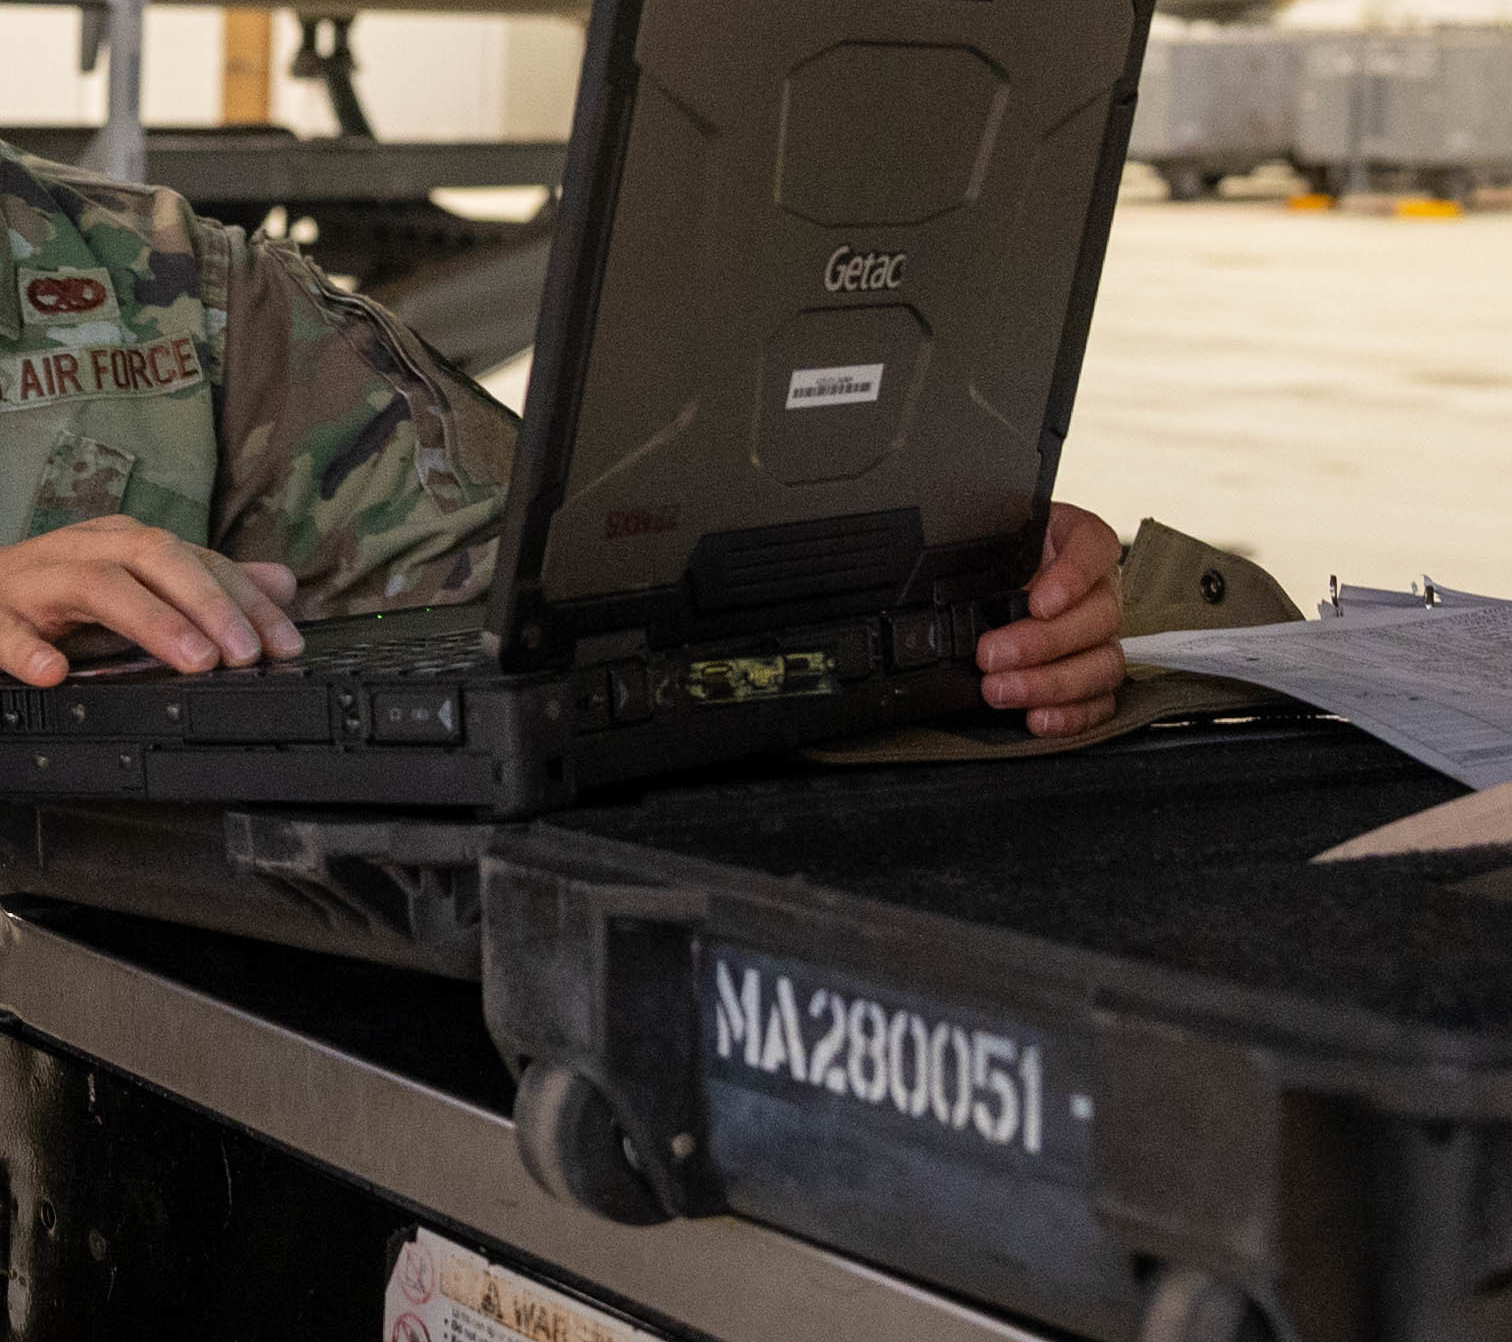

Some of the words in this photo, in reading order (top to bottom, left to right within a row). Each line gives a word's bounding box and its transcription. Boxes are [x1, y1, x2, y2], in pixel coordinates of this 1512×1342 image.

[824, 246, 907, 292] Getac
[20, 353, 83, 400] AIR
[91, 339, 199, 390] FORCE
[715, 959, 1045, 1155] MA280051
